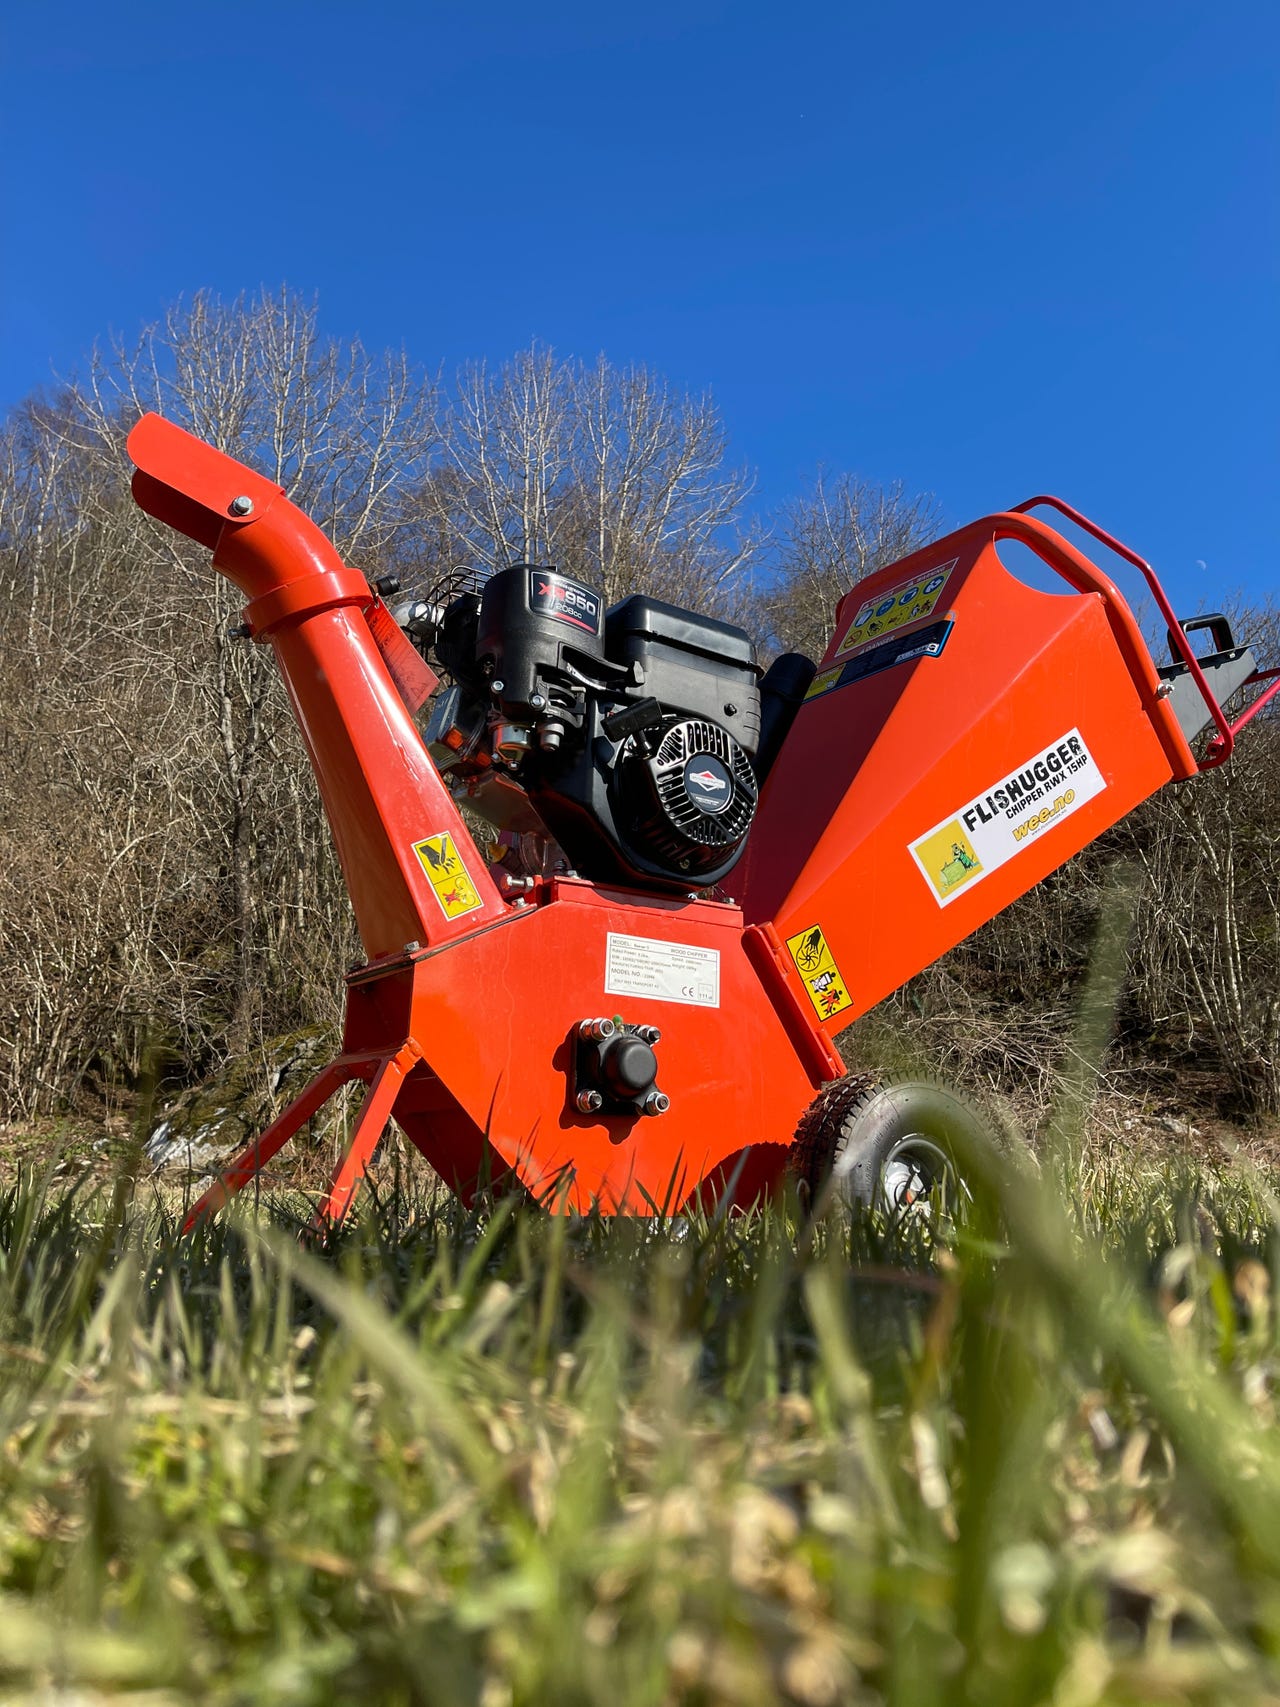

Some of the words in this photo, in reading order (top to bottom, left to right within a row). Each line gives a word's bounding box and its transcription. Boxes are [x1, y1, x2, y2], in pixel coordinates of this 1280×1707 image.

[962, 736, 1083, 832] FLISHUGGER
[1005, 787, 1044, 819] CHIPPER
[1043, 772, 1067, 793] RWX
[1066, 754, 1088, 775] 15HP
[1012, 788, 1076, 842] wee.no
